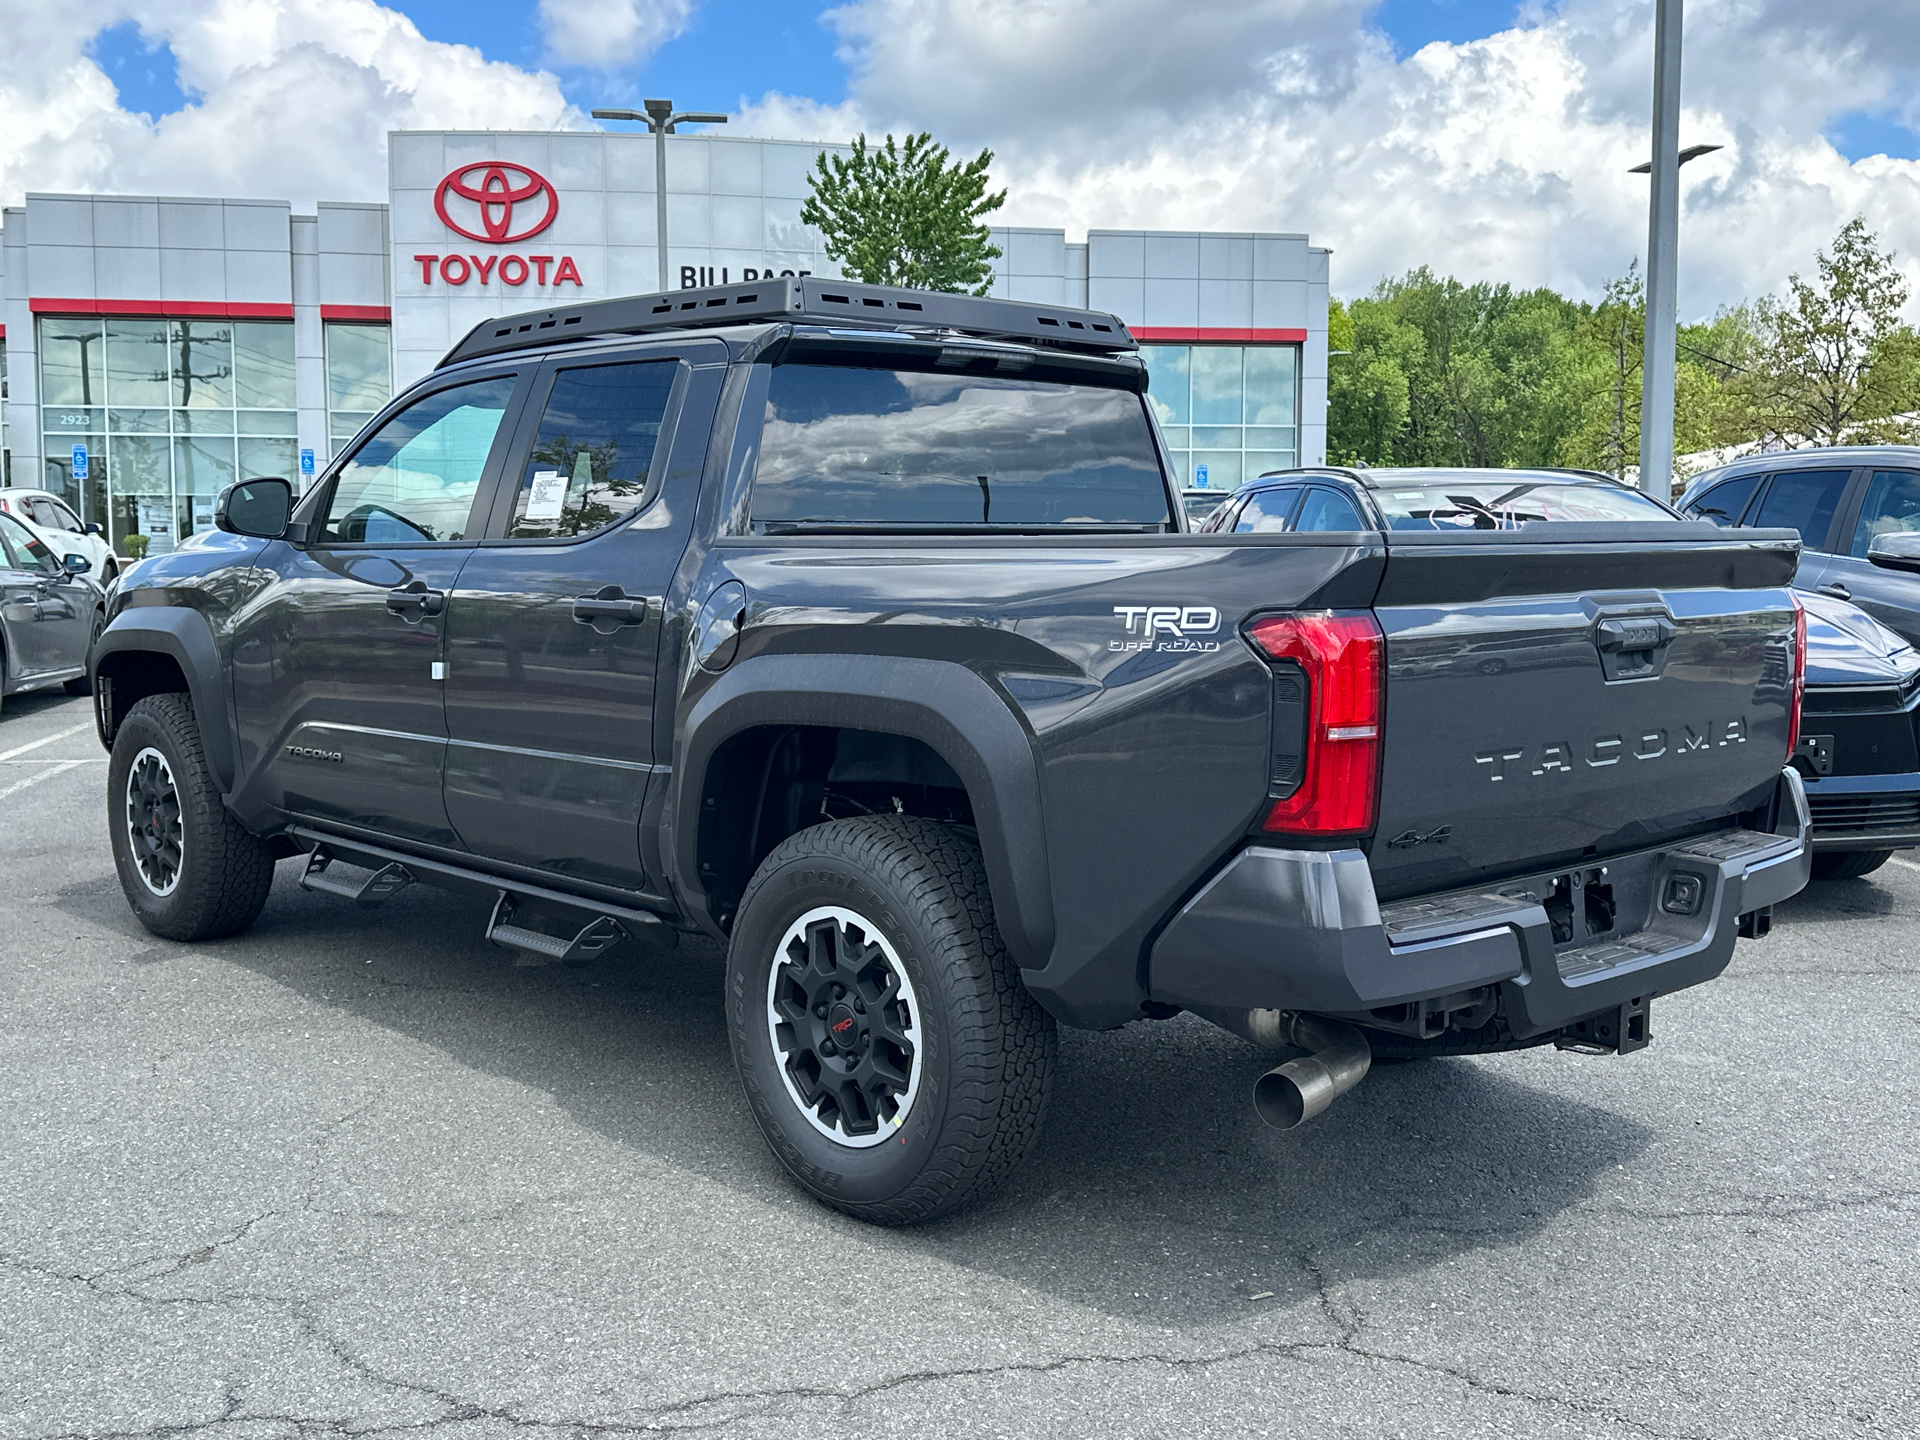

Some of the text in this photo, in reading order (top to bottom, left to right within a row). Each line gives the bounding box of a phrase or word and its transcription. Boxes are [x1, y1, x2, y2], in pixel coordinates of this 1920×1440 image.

[414, 254, 583, 286] TOYOTA
[60, 414, 90, 425] 2923
[1113, 606, 1222, 642] TRD
[1108, 639, 1221, 652] OFF ROAD
[285, 745, 343, 763] TACOMA
[1474, 716, 1748, 782] TACOMA
[832, 1018, 853, 1034] TRD
